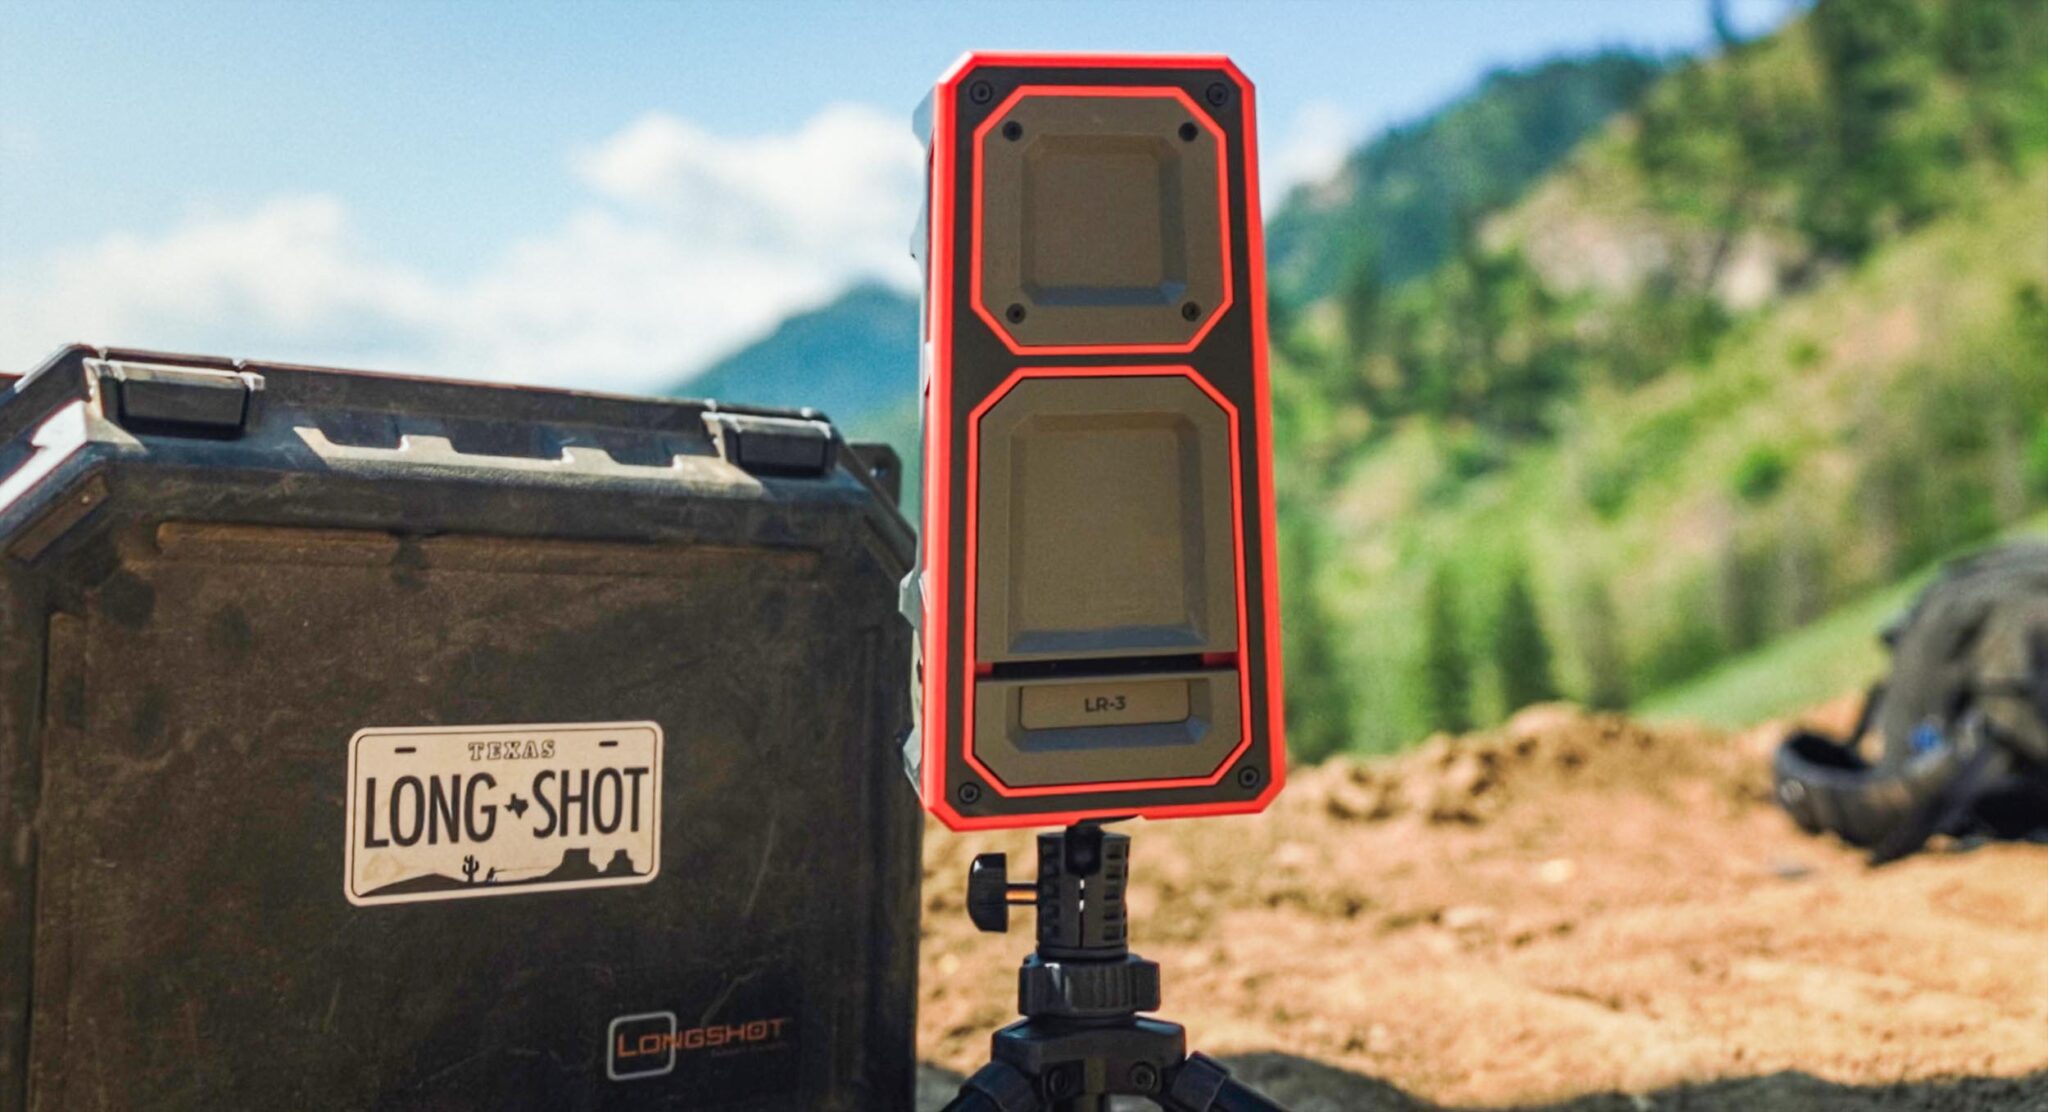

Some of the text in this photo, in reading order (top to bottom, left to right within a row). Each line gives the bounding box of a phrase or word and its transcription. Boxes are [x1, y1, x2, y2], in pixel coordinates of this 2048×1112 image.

[1084, 695, 1127, 713] LR-3
[468, 740, 556, 761] TEXAS
[364, 766, 649, 848] LONG SHOT
[617, 1017, 787, 1058] LONGSHOT
